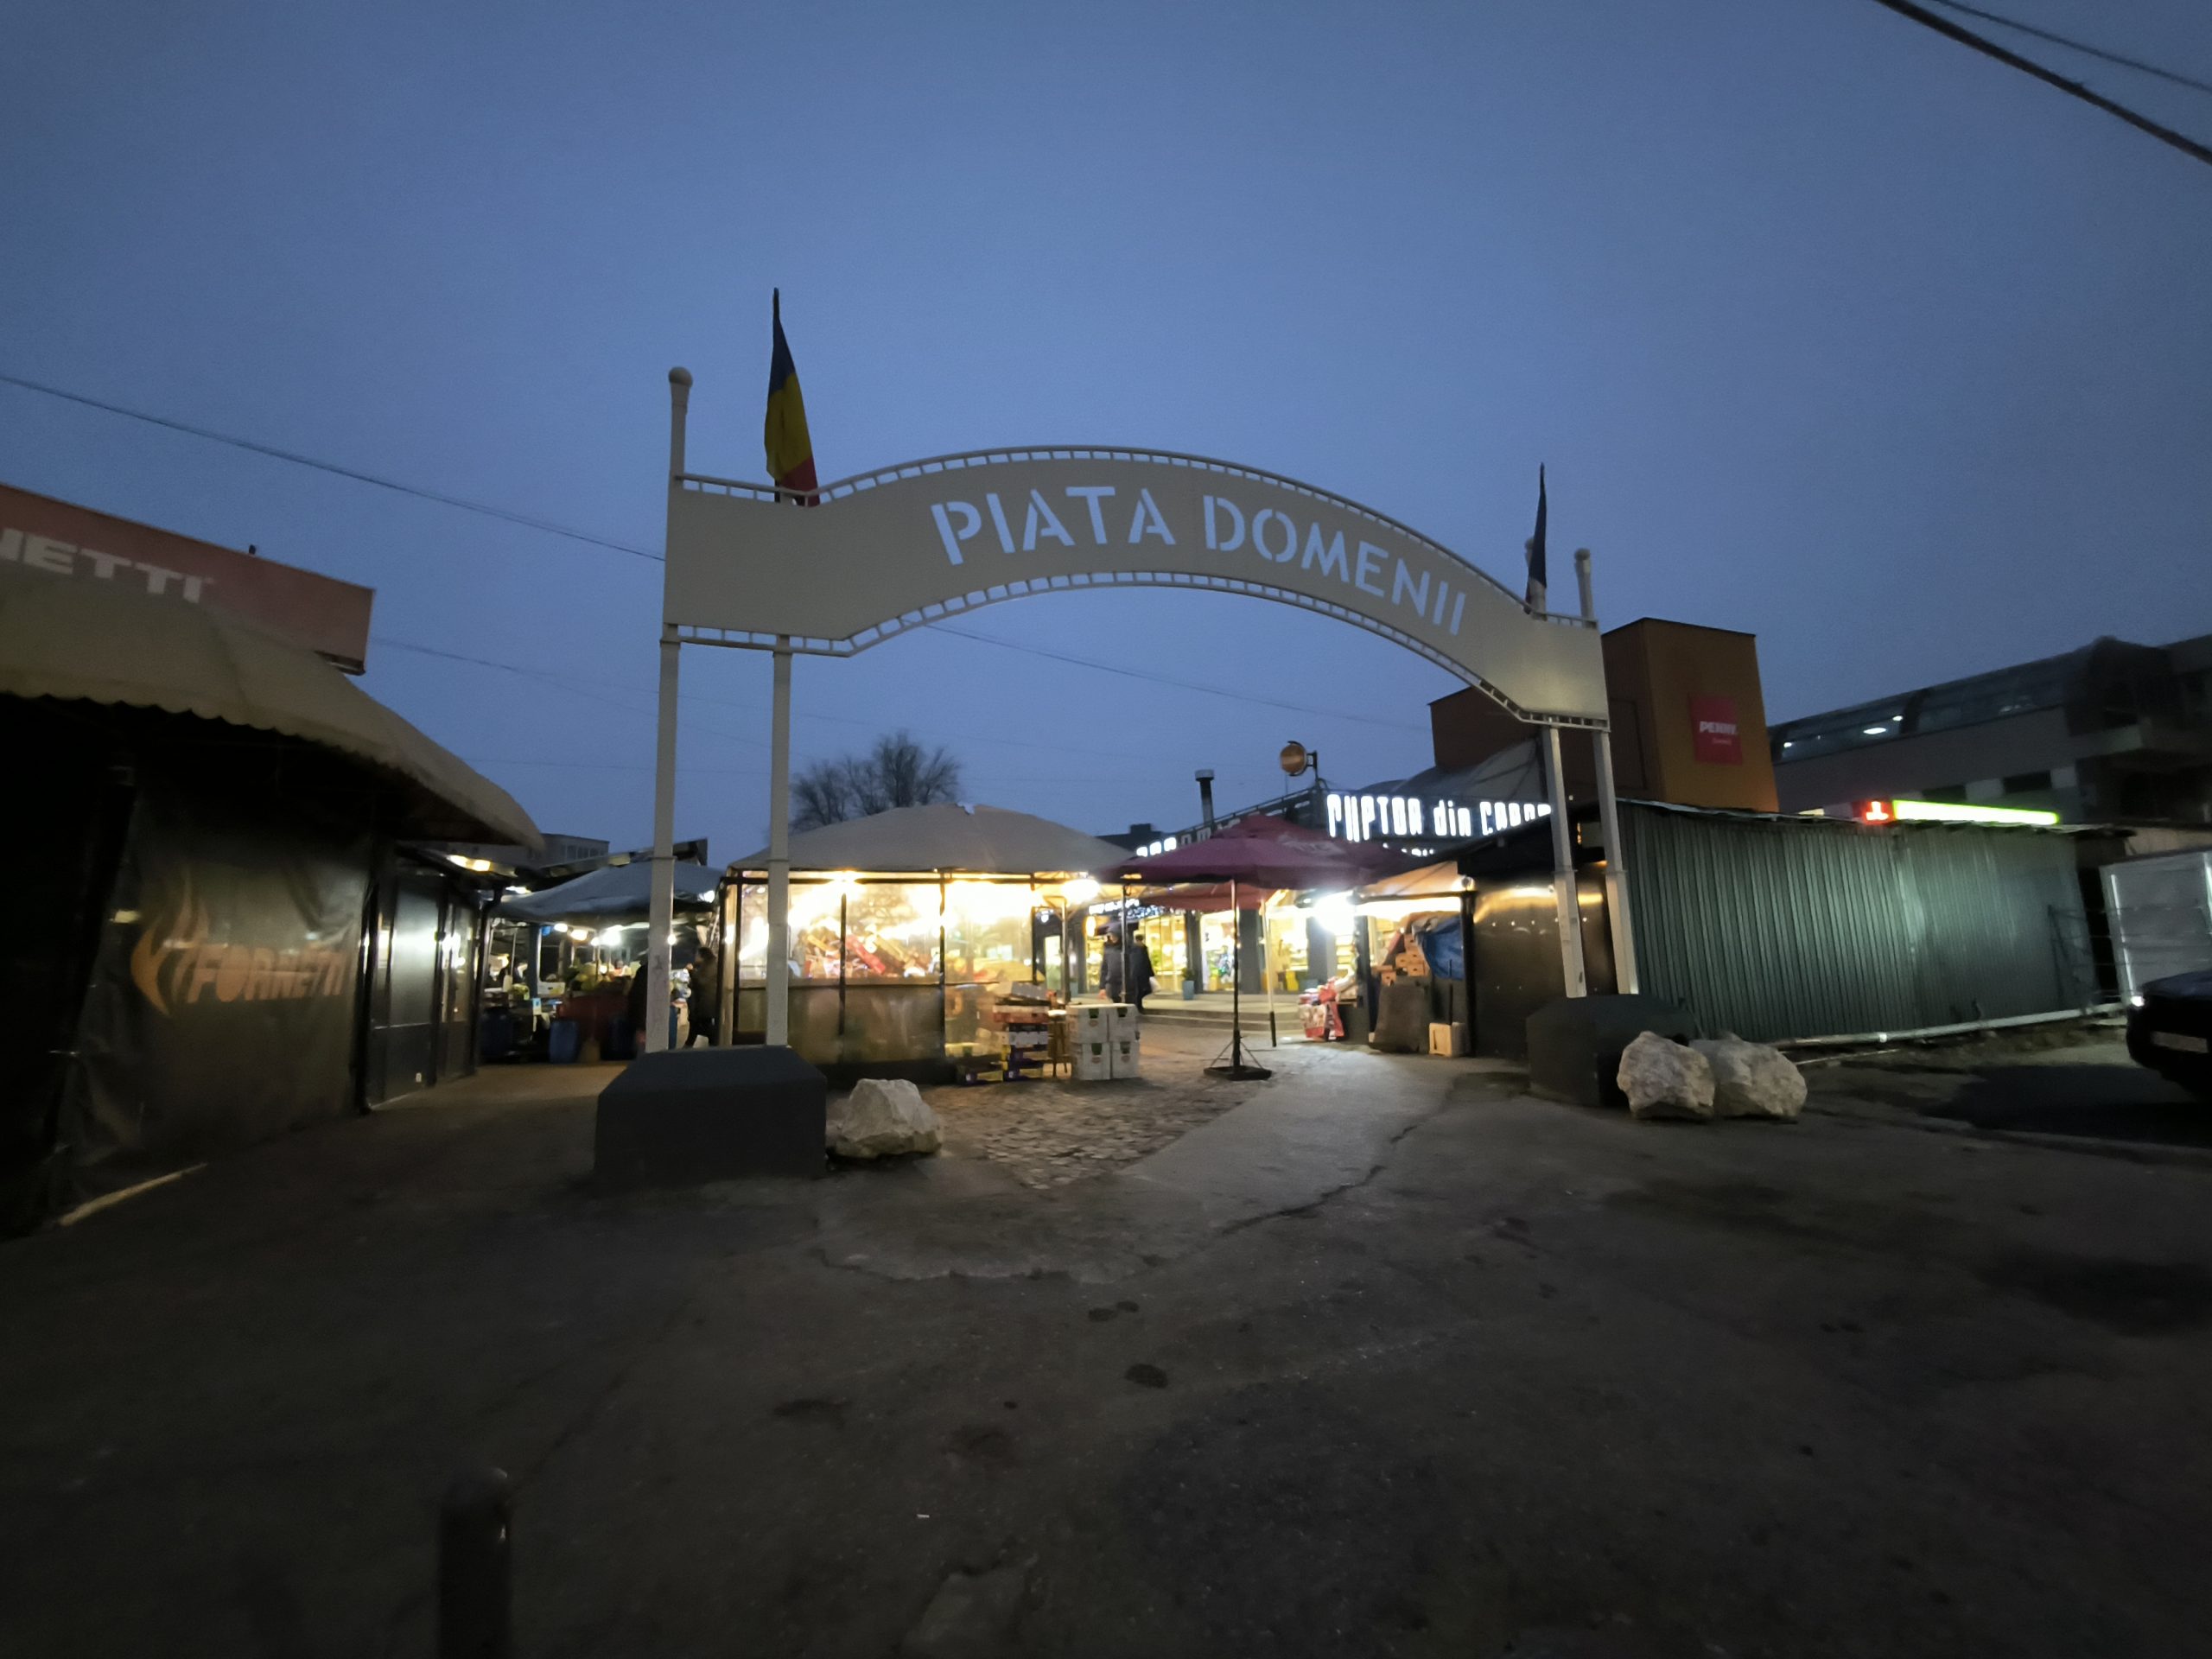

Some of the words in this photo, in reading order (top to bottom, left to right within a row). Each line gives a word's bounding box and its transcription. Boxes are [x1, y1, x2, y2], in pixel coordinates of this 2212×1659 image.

[931, 486, 1177, 566] PIATA
[1203, 494, 1466, 636] DOMENII
[1326, 793, 1423, 843] CUPTOR
[1433, 799, 1471, 837] din
